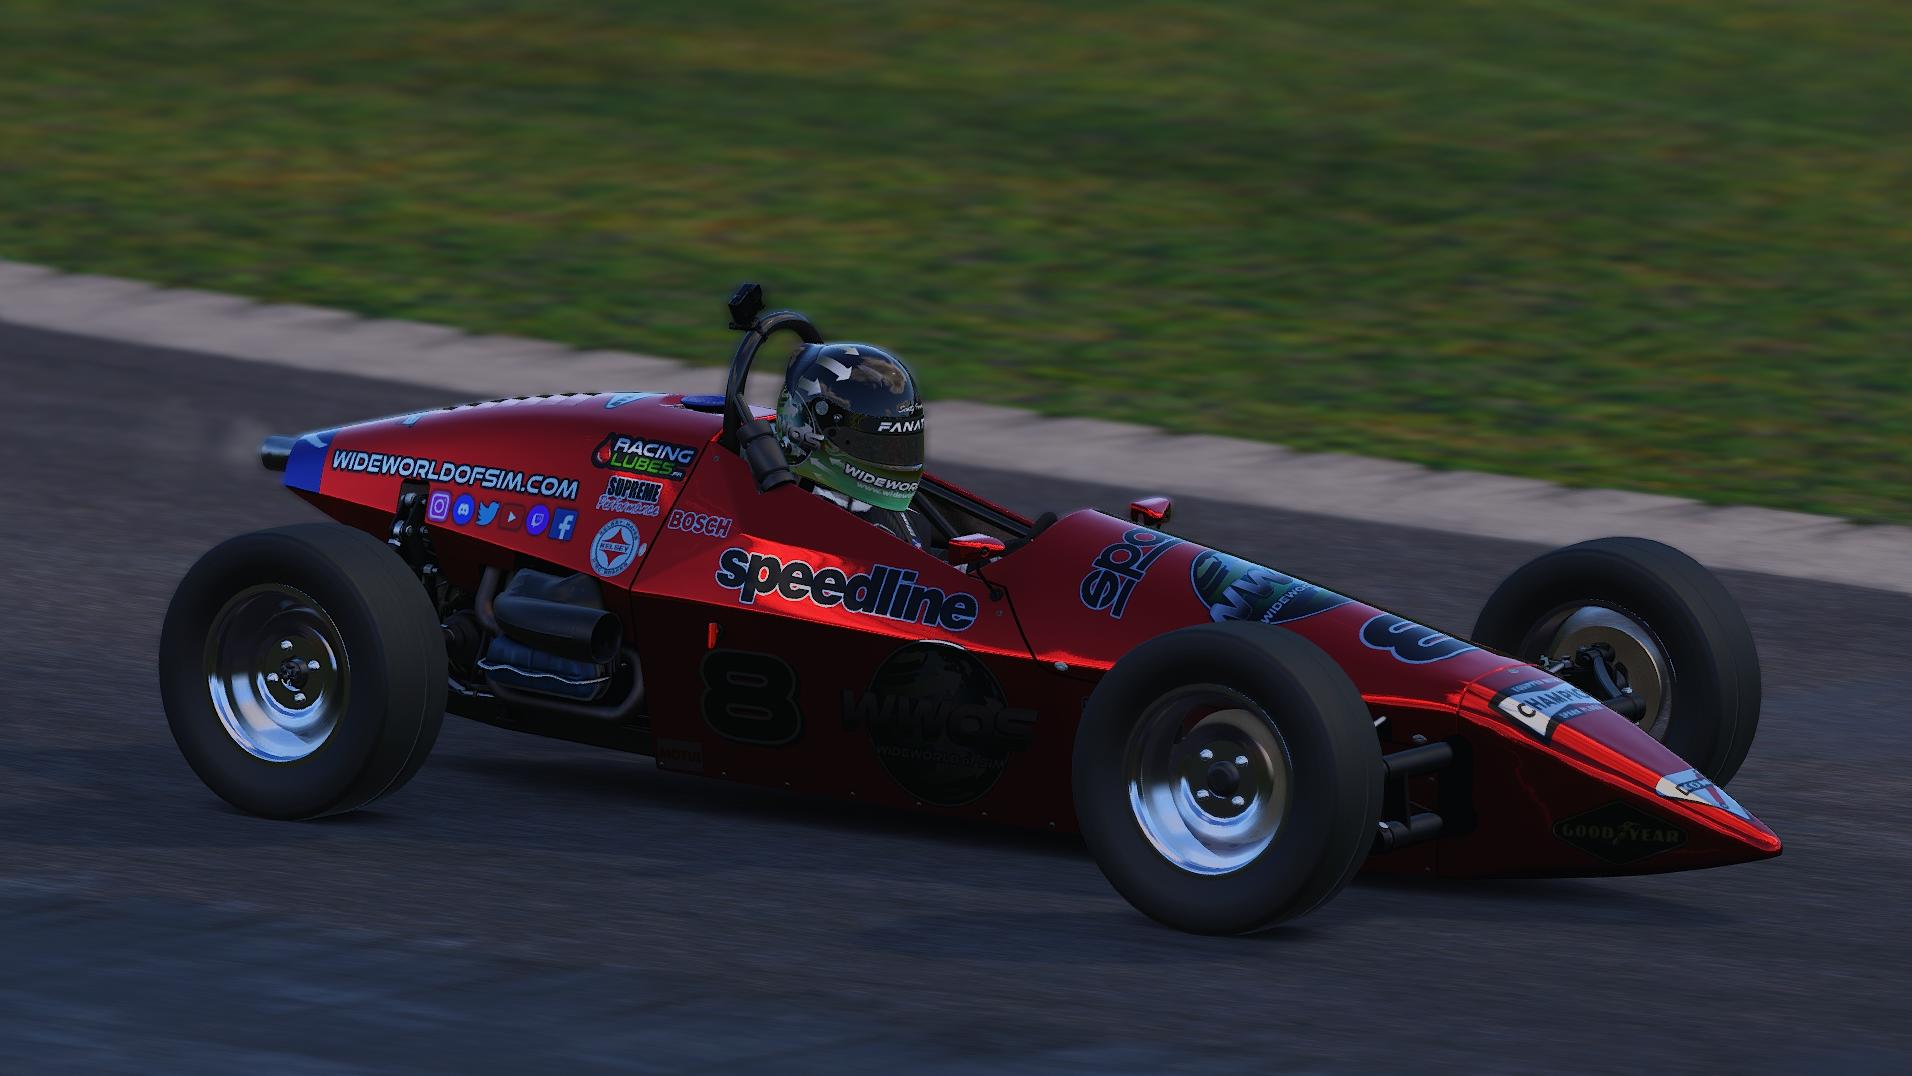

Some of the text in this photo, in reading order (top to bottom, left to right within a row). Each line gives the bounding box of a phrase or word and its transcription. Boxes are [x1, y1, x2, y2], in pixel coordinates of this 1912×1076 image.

[613, 437, 696, 464] RACING
[331, 448, 580, 500] WIDEWORLDOFSIM.COM
[606, 476, 662, 503] SUPREME
[668, 509, 733, 538] BOSCH
[715, 548, 978, 630] speedline
[701, 648, 802, 746] 8
